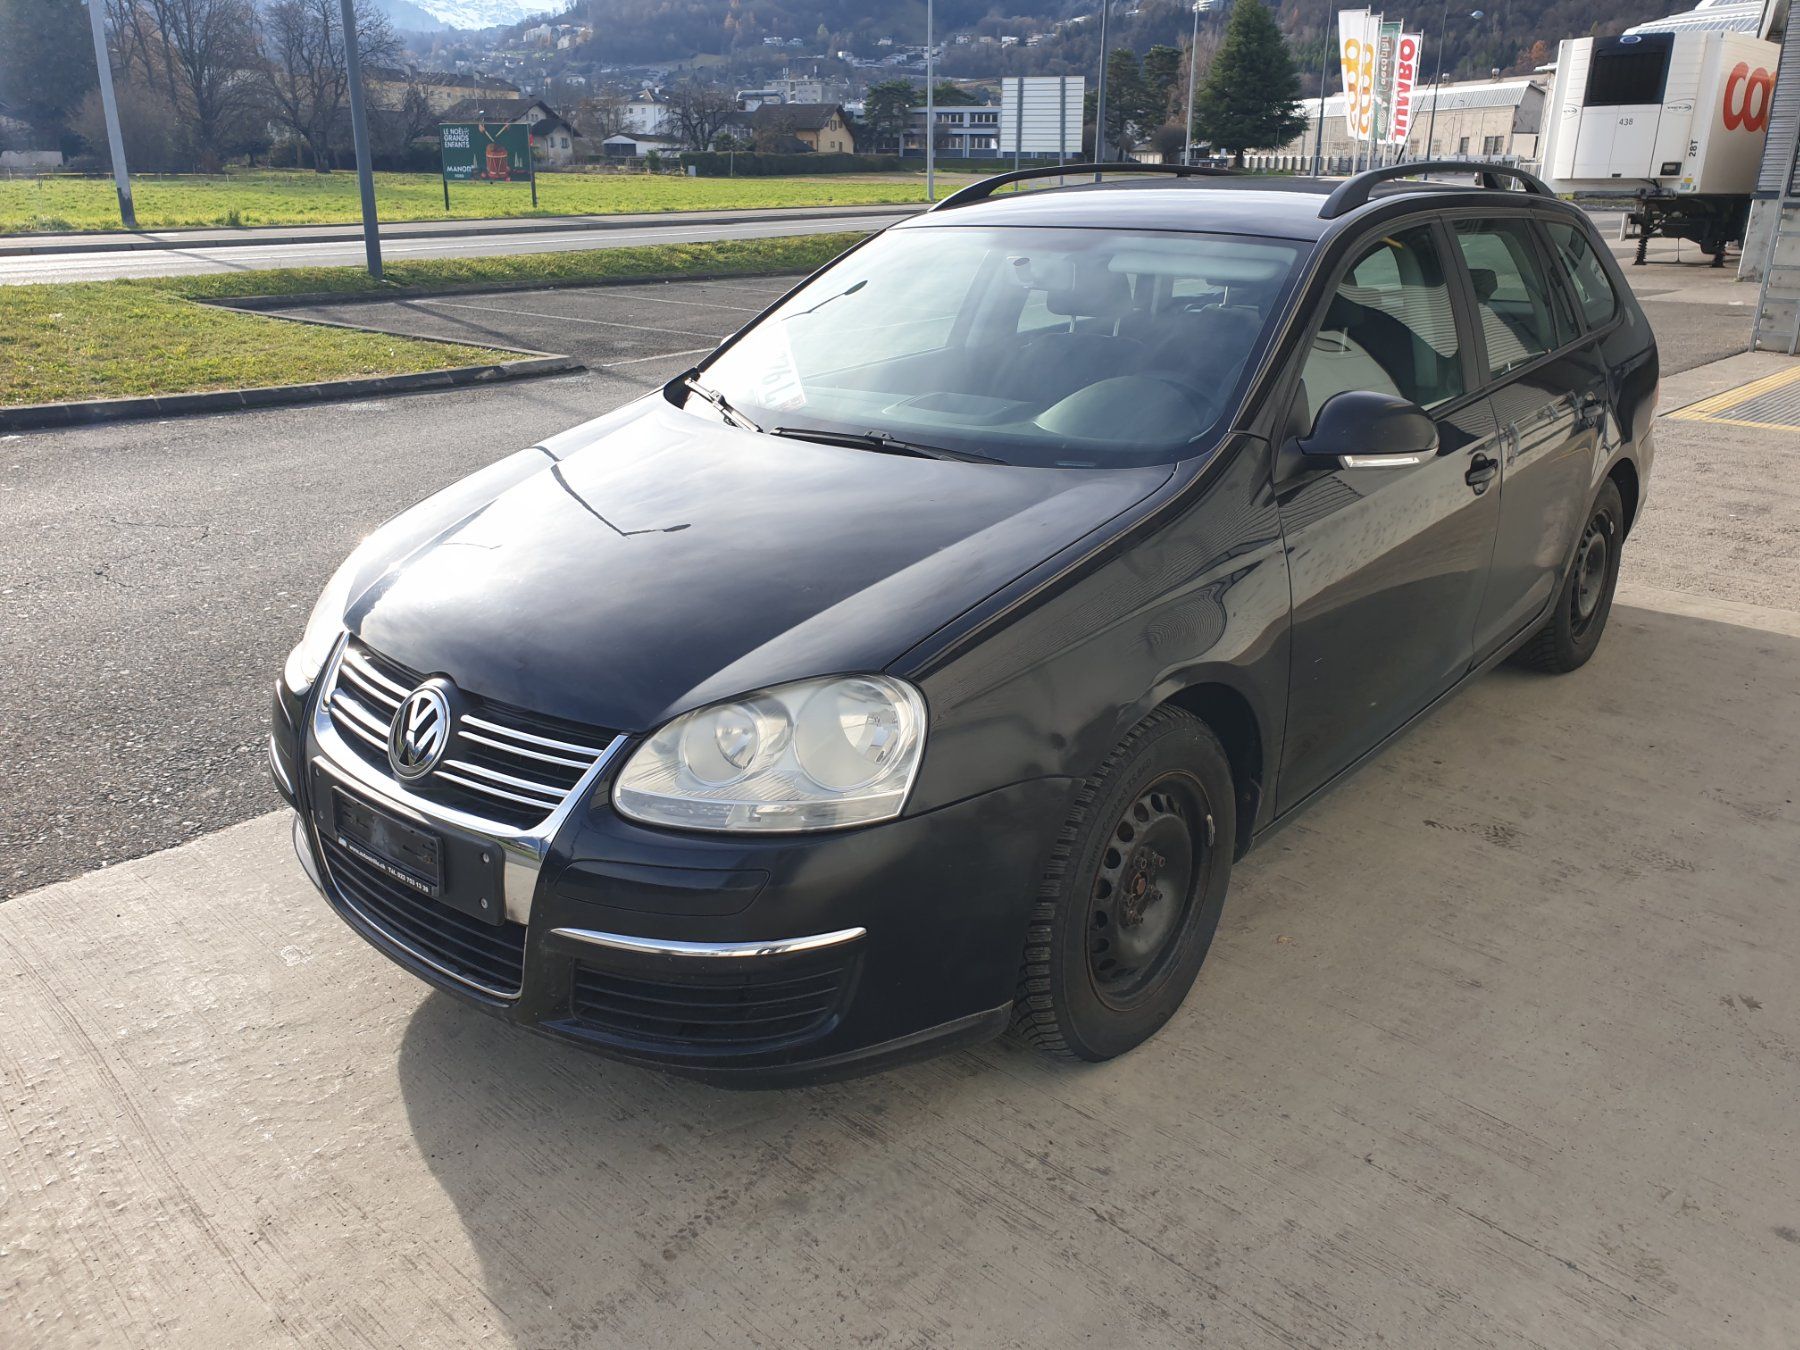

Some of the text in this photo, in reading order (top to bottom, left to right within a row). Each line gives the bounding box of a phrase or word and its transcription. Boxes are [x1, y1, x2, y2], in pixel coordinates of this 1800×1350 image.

[1723, 62, 1777, 133] co
[1618, 117, 1634, 126] 438
[1688, 139, 1699, 157] 28T
